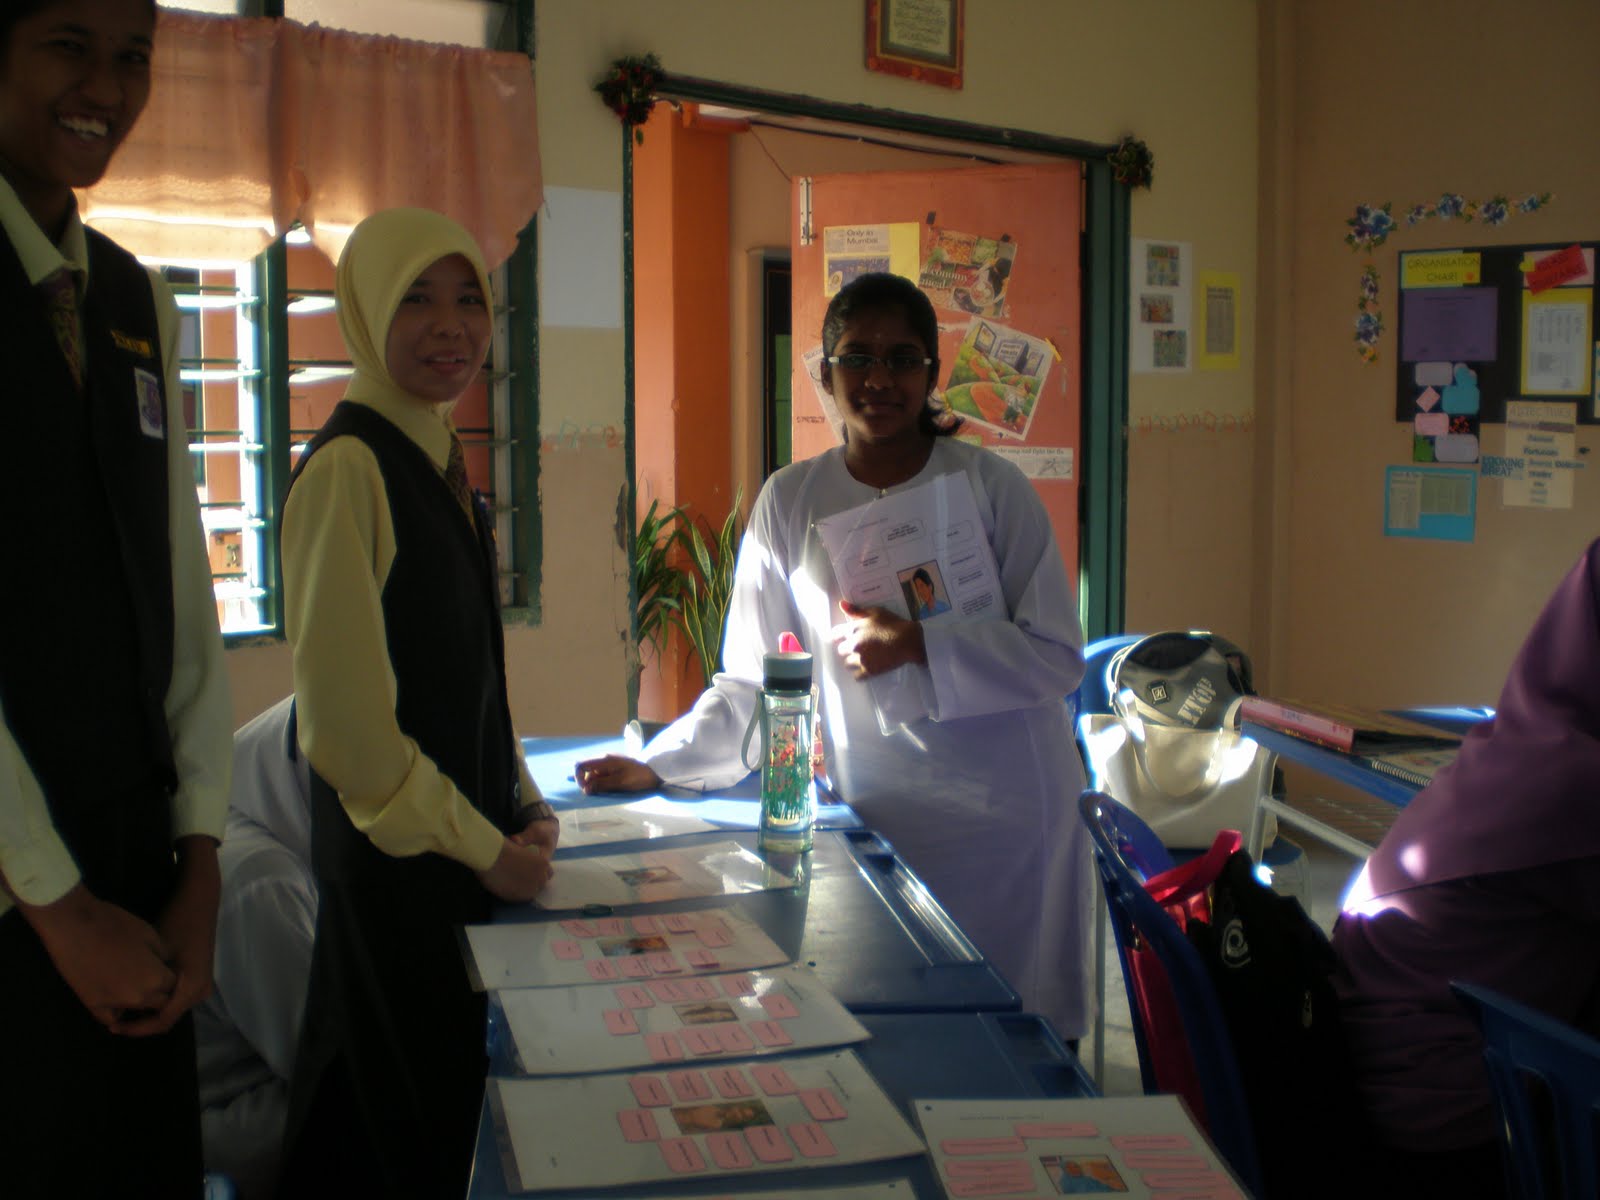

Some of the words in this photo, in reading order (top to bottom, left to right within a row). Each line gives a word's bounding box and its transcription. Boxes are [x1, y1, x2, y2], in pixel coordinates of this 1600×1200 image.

[847, 229, 864, 237] Only
[847, 237, 878, 245] Mumbai
[1408, 256, 1479, 268] ORGANISATION
[1426, 273, 1458, 281] CHART
